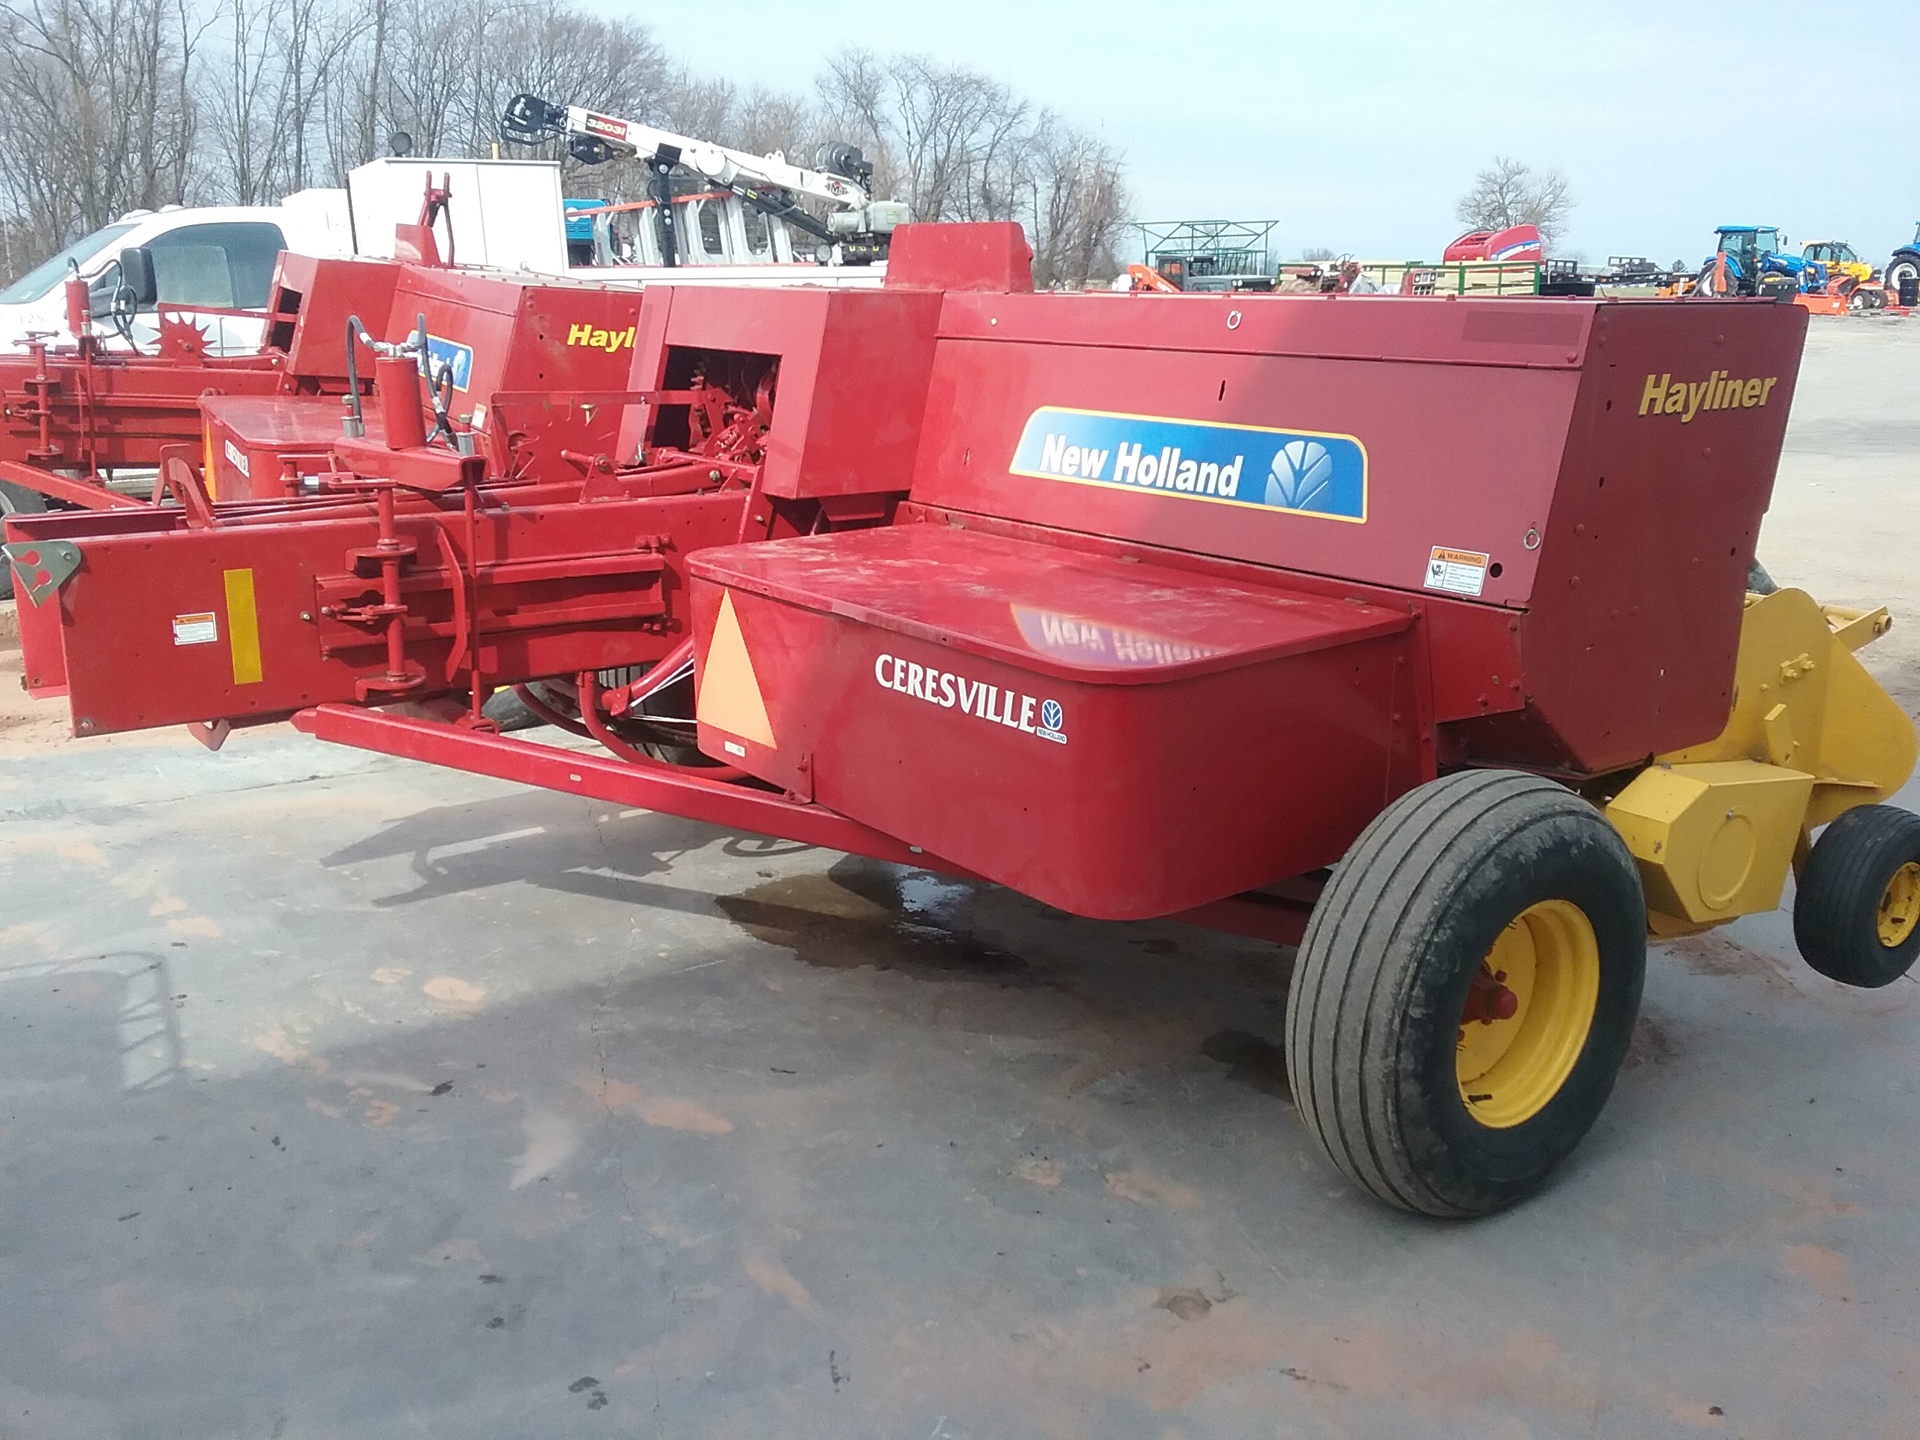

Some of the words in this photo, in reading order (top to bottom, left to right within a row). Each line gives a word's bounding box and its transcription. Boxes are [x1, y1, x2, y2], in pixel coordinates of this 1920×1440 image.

[567, 323, 636, 353] Hayl
[1638, 370, 1777, 423] Hayliner
[1040, 433, 1109, 479] New
[1113, 441, 1244, 497] Holland
[1446, 552, 1482, 564] WARNING
[875, 653, 1037, 734] CERESVILLE
